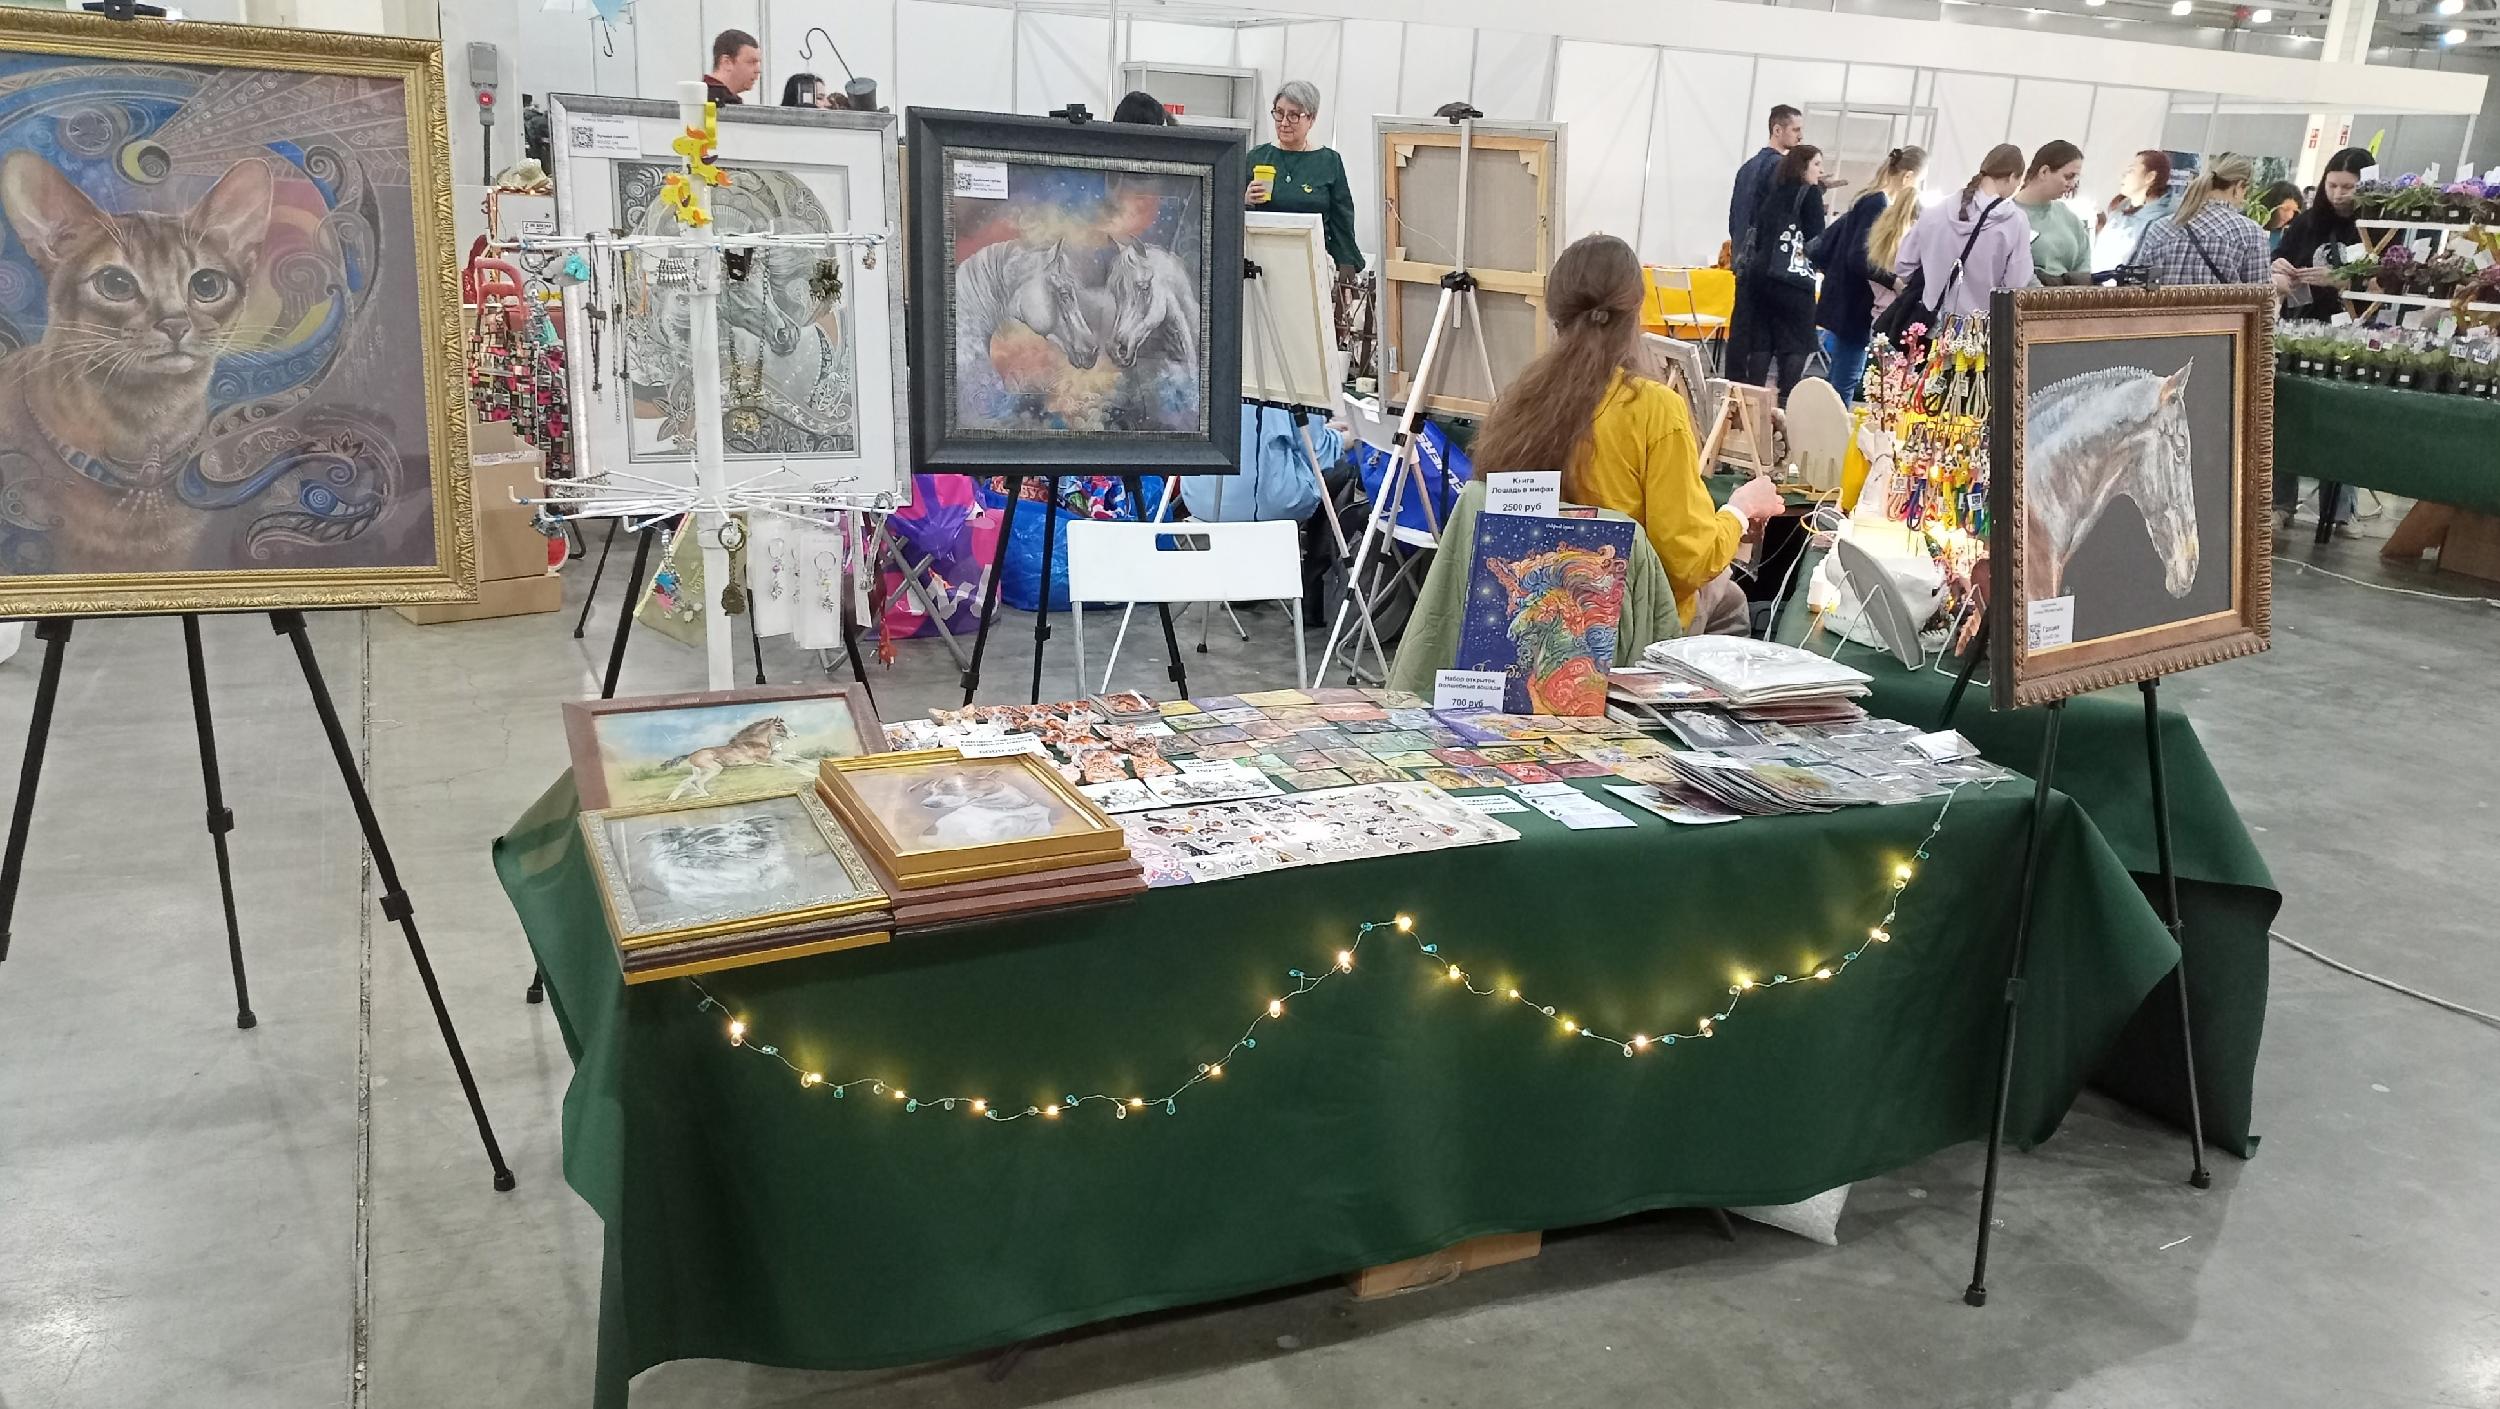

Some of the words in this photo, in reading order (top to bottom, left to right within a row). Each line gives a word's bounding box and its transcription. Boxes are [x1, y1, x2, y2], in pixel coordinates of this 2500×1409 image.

[1529, 485, 1554, 494] мифах
[1502, 503, 1523, 512] 2500
[1524, 502, 1542, 512] руб
[1452, 698, 1467, 706] 700
[1468, 699, 1484, 708] руб
